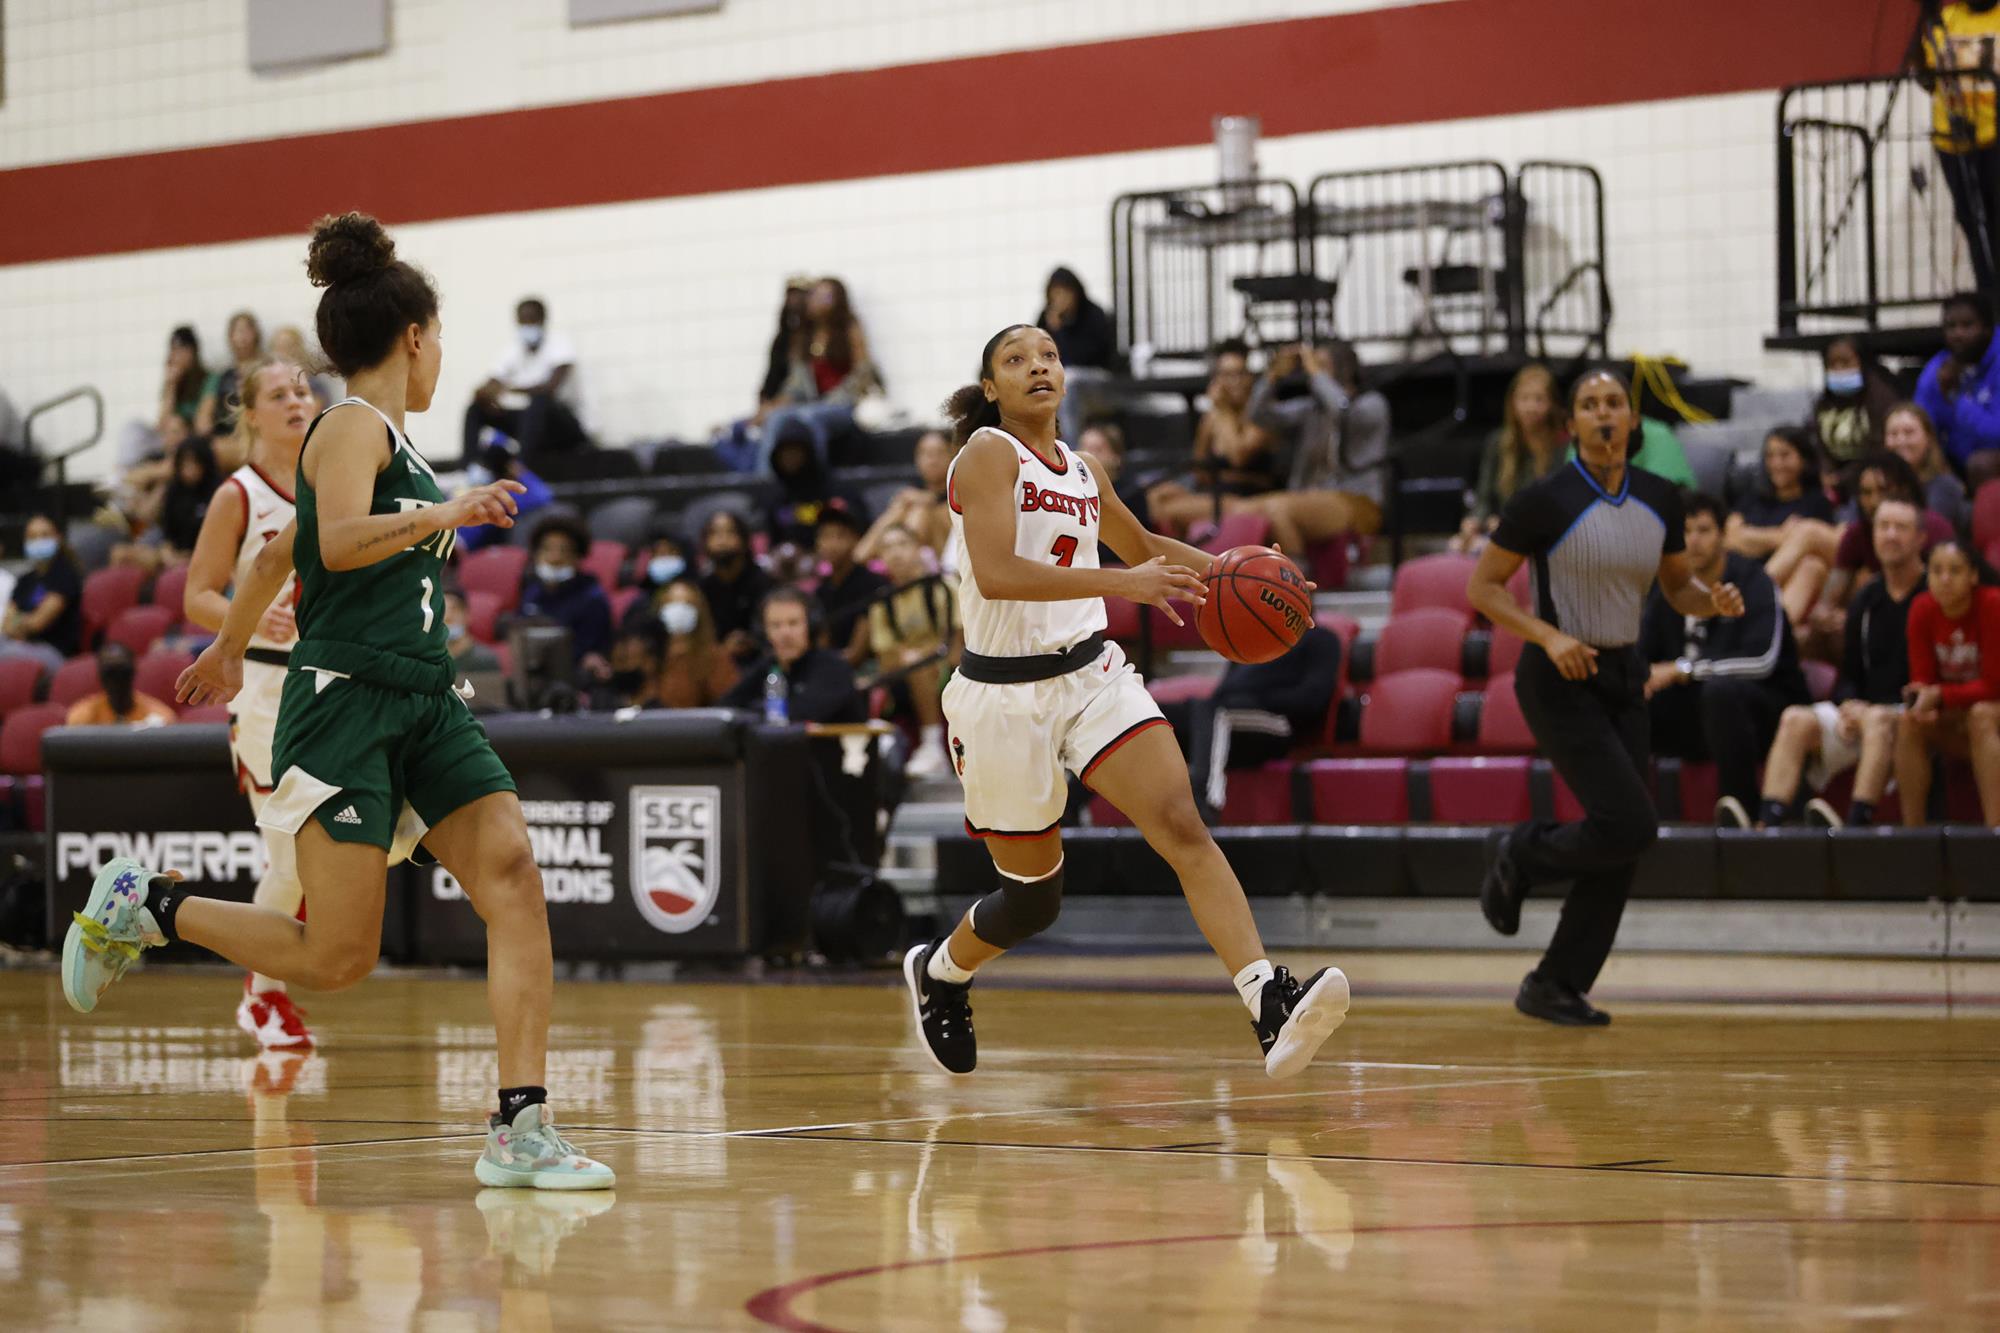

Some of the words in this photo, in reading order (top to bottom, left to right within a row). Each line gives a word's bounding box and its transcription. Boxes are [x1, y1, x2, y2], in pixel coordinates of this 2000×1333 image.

[421, 575, 434, 634] 1
[334, 815, 362, 825] adidas
[646, 802, 704, 829] SSC
[56, 831, 264, 882] POWERA
